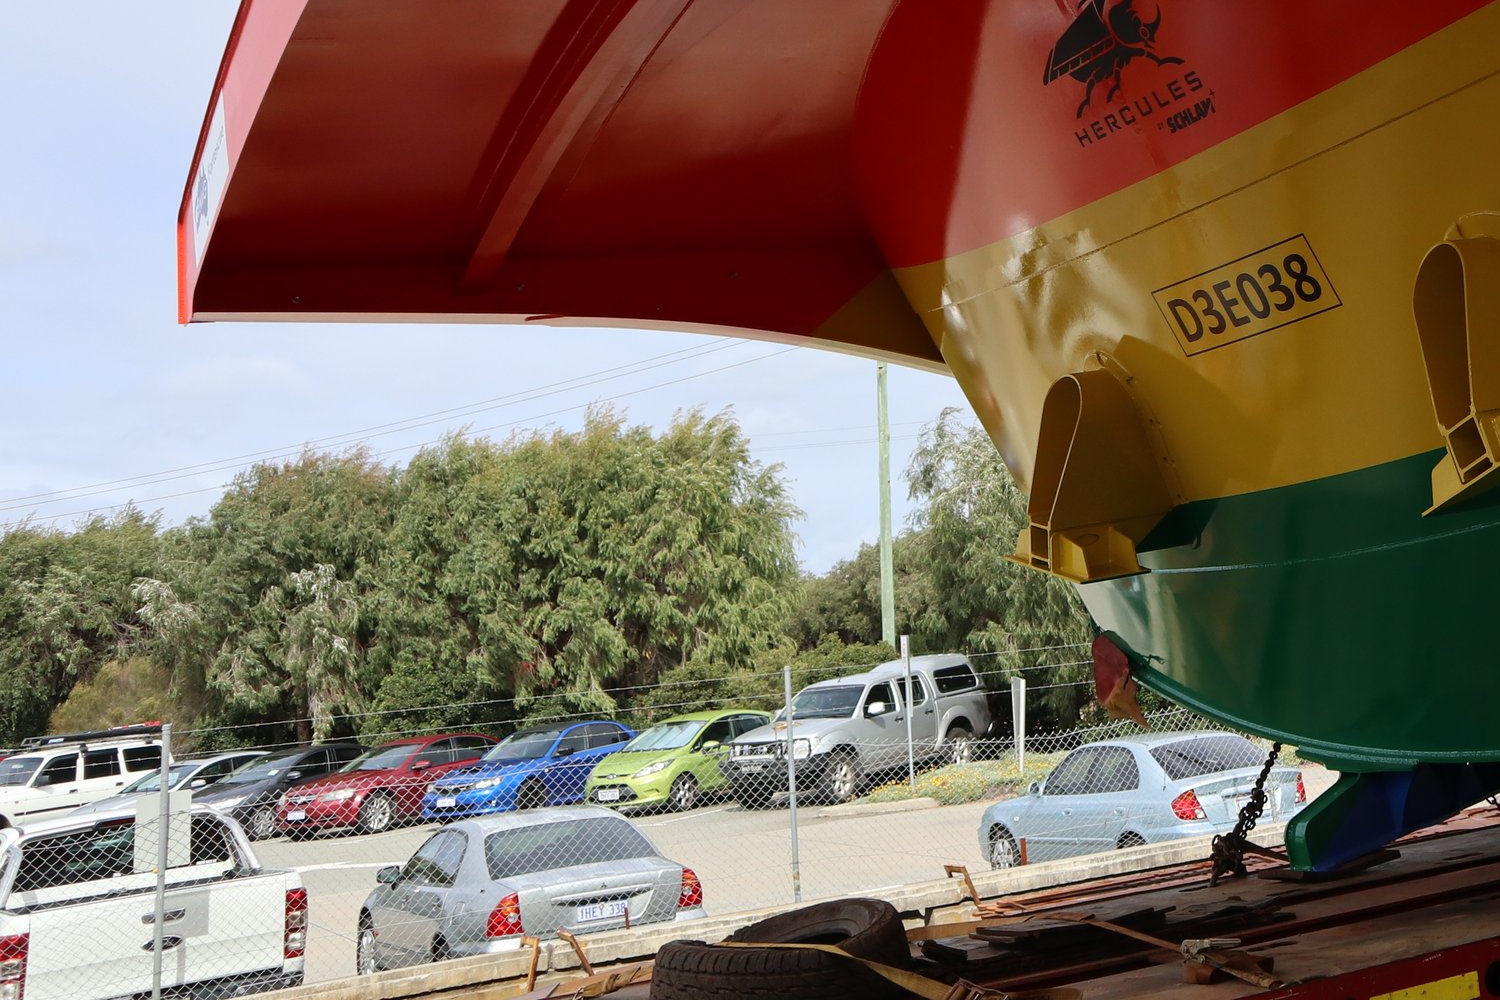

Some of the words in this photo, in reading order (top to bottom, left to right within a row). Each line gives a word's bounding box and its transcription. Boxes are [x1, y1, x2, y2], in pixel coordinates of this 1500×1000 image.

[1074, 71, 1203, 148] HERCULES
[1167, 98, 1216, 134] SCHLAM
[1167, 253, 1322, 343] D3E038
